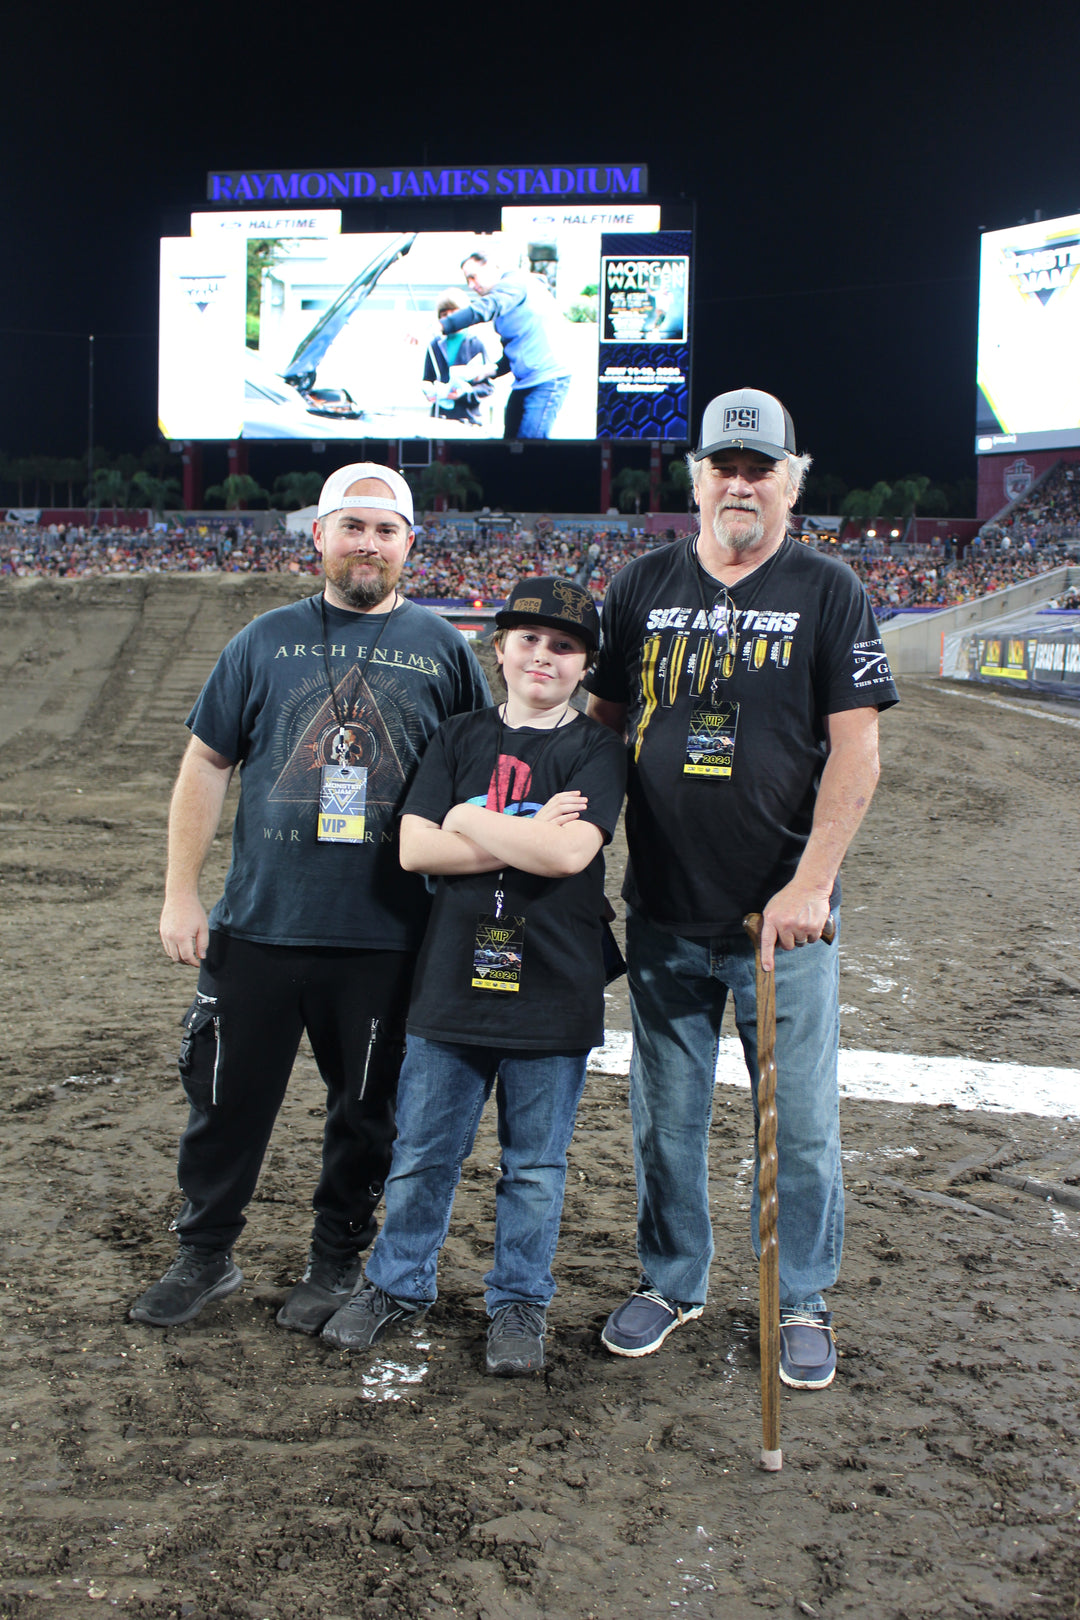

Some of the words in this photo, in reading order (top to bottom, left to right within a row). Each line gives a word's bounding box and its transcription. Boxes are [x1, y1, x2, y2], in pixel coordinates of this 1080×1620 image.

[211, 171, 377, 200] RAYMOND
[380, 169, 490, 198] JAMES
[495, 167, 643, 196] STADIUM
[248, 218, 317, 229] HALFTIME
[562, 214, 635, 225] HALFTIME
[607, 261, 685, 277] MORGAN
[725, 409, 756, 429] PSI
[646, 607, 693, 630] SIZE
[853, 639, 882, 649] GRUNT
[274, 644, 346, 659] ARCH
[356, 646, 441, 676] ENEMY
[705, 715, 724, 727] VIP
[702, 755, 731, 765] 2024
[321, 818, 347, 833] VIP
[263, 827, 302, 842] WAR
[490, 929, 510, 942] VIP
[489, 969, 518, 980] 2024
